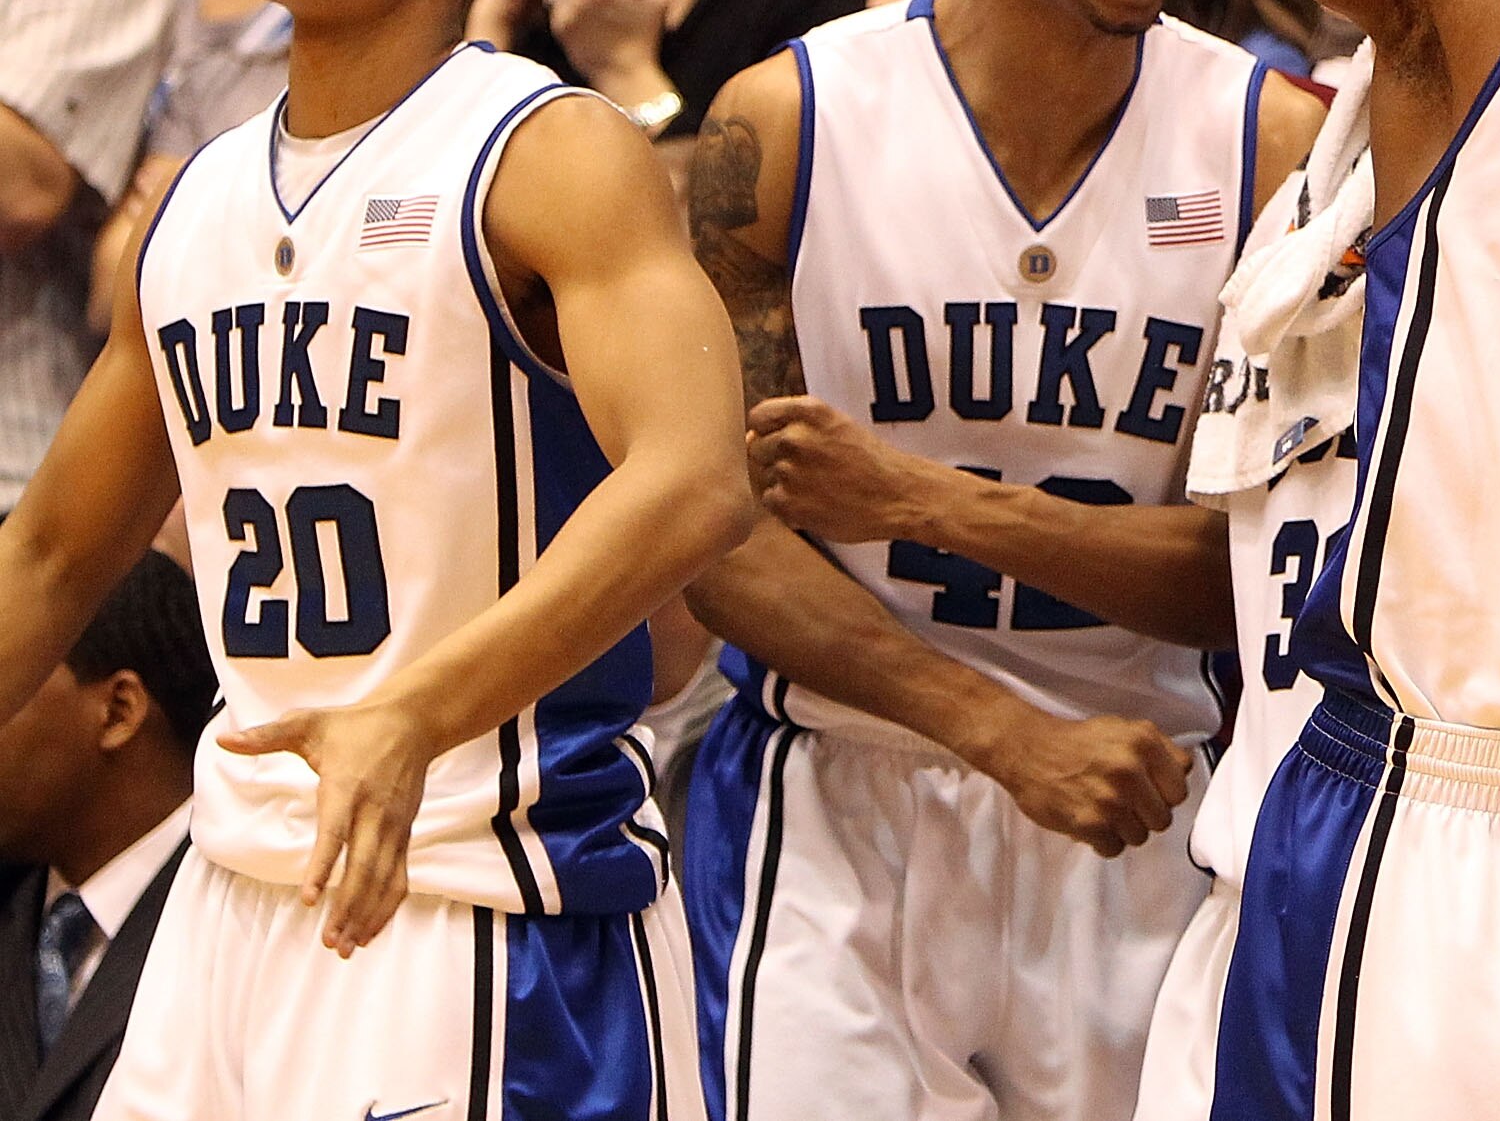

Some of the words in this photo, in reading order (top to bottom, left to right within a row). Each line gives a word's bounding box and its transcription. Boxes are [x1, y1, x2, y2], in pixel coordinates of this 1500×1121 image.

[1029, 254, 1050, 274] D
[157, 300, 410, 446] DUKE
[859, 301, 1204, 443] DUKE
[221, 483, 392, 659] 20
[1263, 519, 1351, 691] 3
